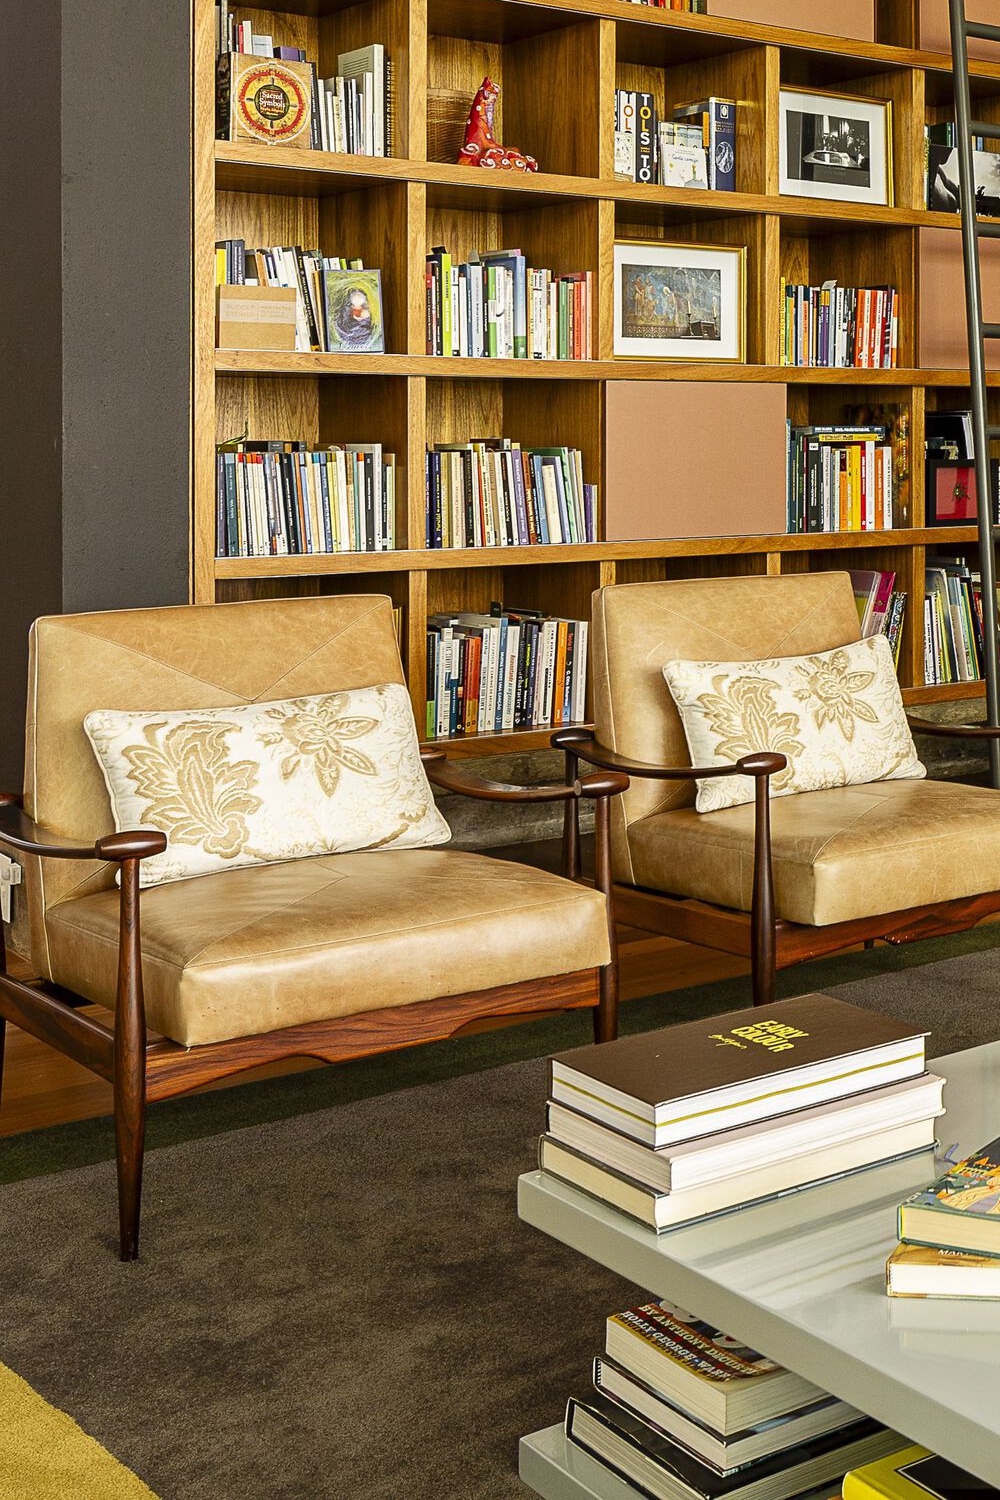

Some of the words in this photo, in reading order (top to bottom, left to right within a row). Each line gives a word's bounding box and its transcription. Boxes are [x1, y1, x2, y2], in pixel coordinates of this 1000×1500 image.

[259, 98, 286, 108] Symbols
[262, 91, 283, 100] Sacred
[731, 1026, 794, 1052] COLOUR
[753, 1020, 809, 1039] EARLY
[620, 1311, 657, 1334] HOLLY
[638, 1304, 658, 1317] BY
[653, 1314, 710, 1352] ANTHONY
